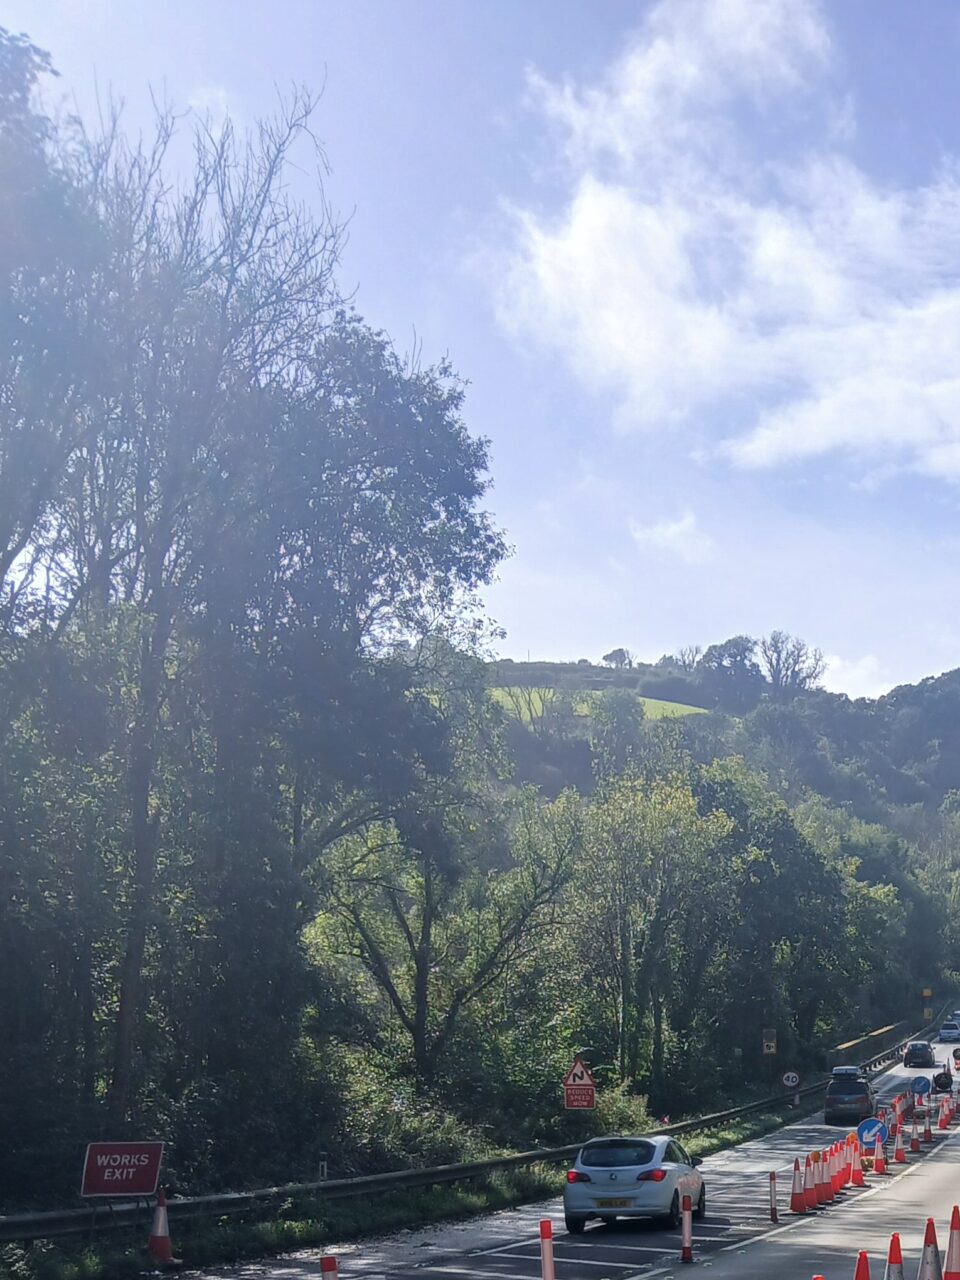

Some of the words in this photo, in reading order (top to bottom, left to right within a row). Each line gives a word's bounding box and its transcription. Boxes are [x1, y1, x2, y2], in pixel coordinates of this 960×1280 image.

[784, 1075, 798, 1083] 40
[97, 1154, 149, 1166] WORKS
[104, 1168, 136, 1180] EXIT
